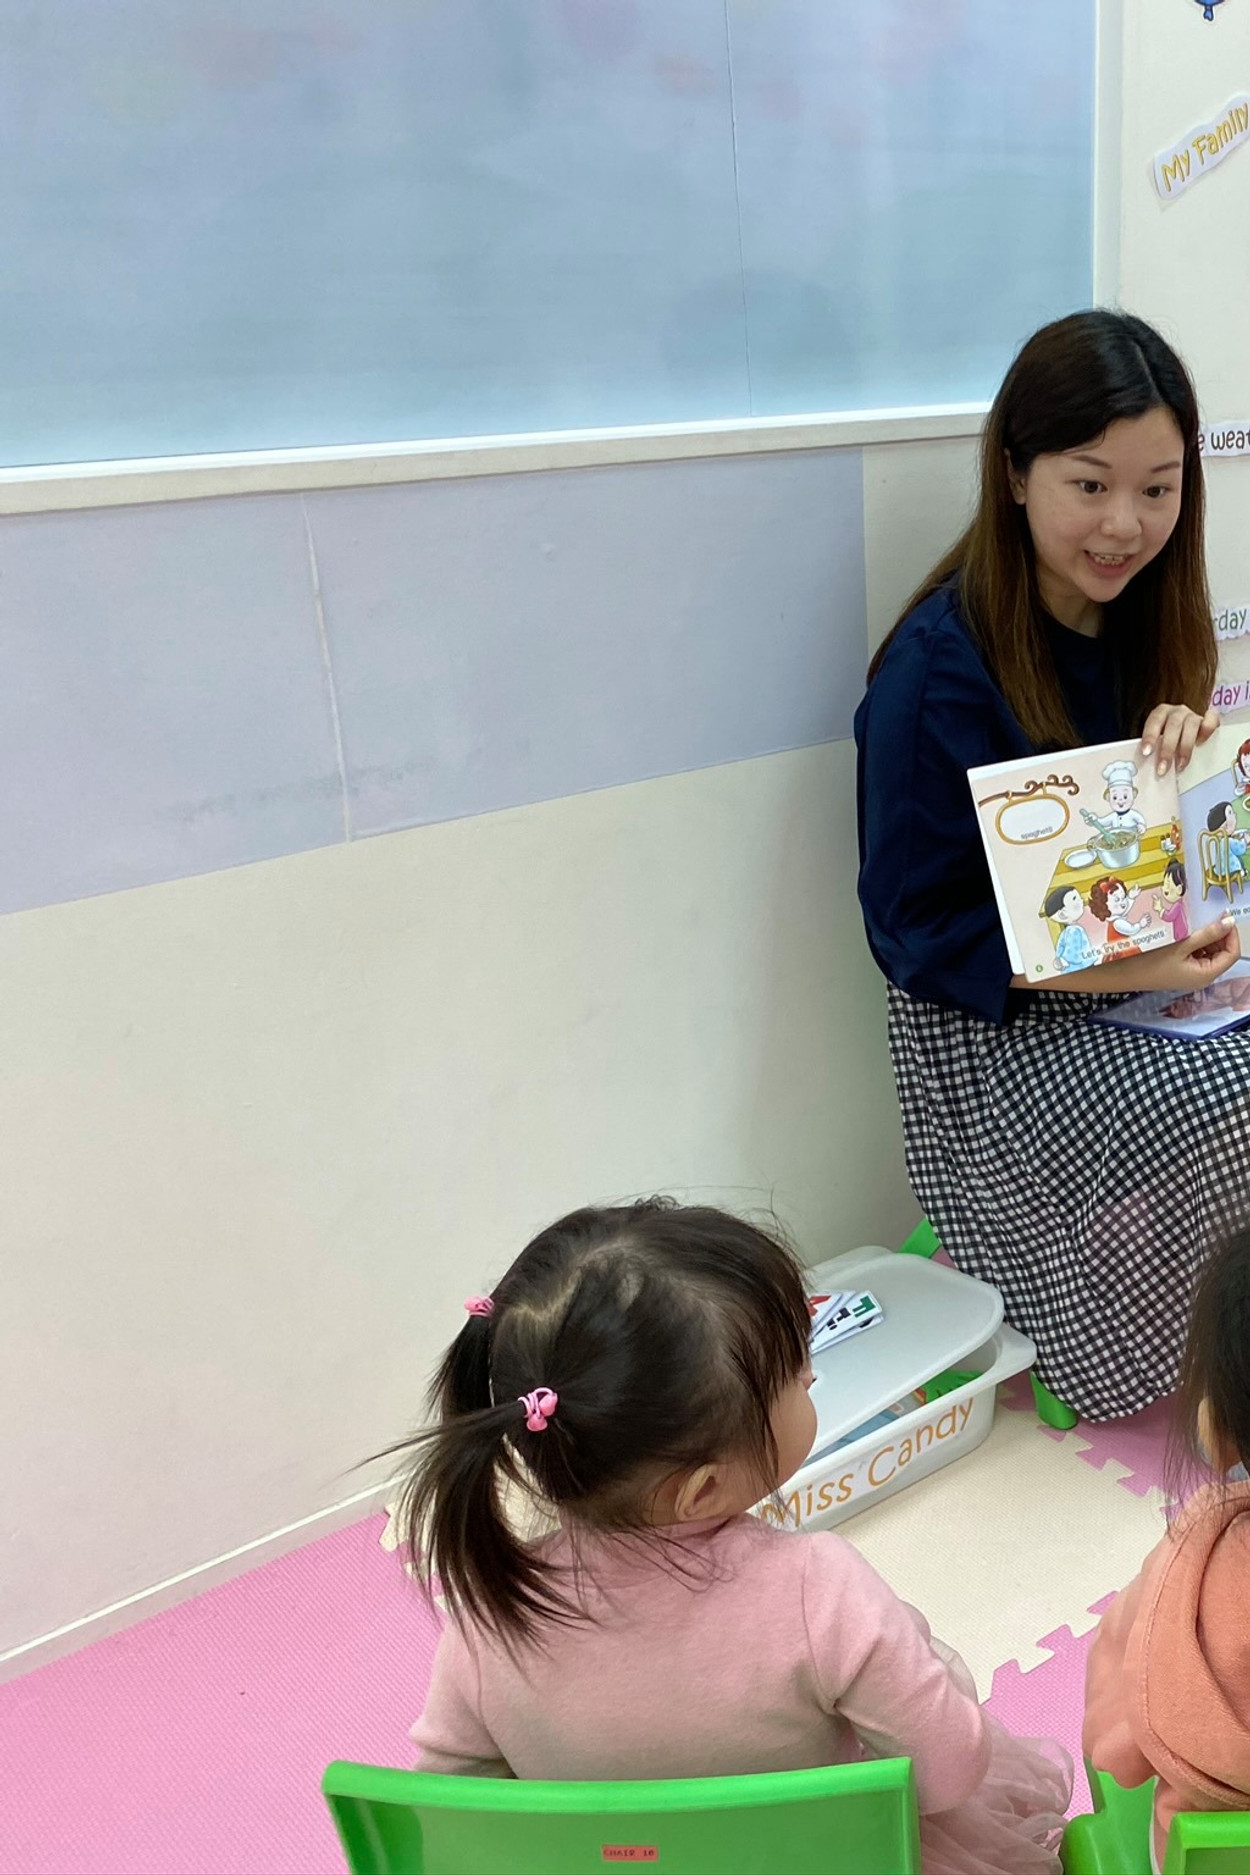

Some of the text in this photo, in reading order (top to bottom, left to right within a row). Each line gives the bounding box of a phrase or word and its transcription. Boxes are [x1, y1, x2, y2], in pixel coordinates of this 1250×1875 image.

[1160, 102, 1250, 192] My Family
[1214, 609, 1247, 632] day
[1211, 684, 1242, 707] day
[1117, 939, 1131, 950] the
[760, 1396, 974, 1527] Miss Candy
